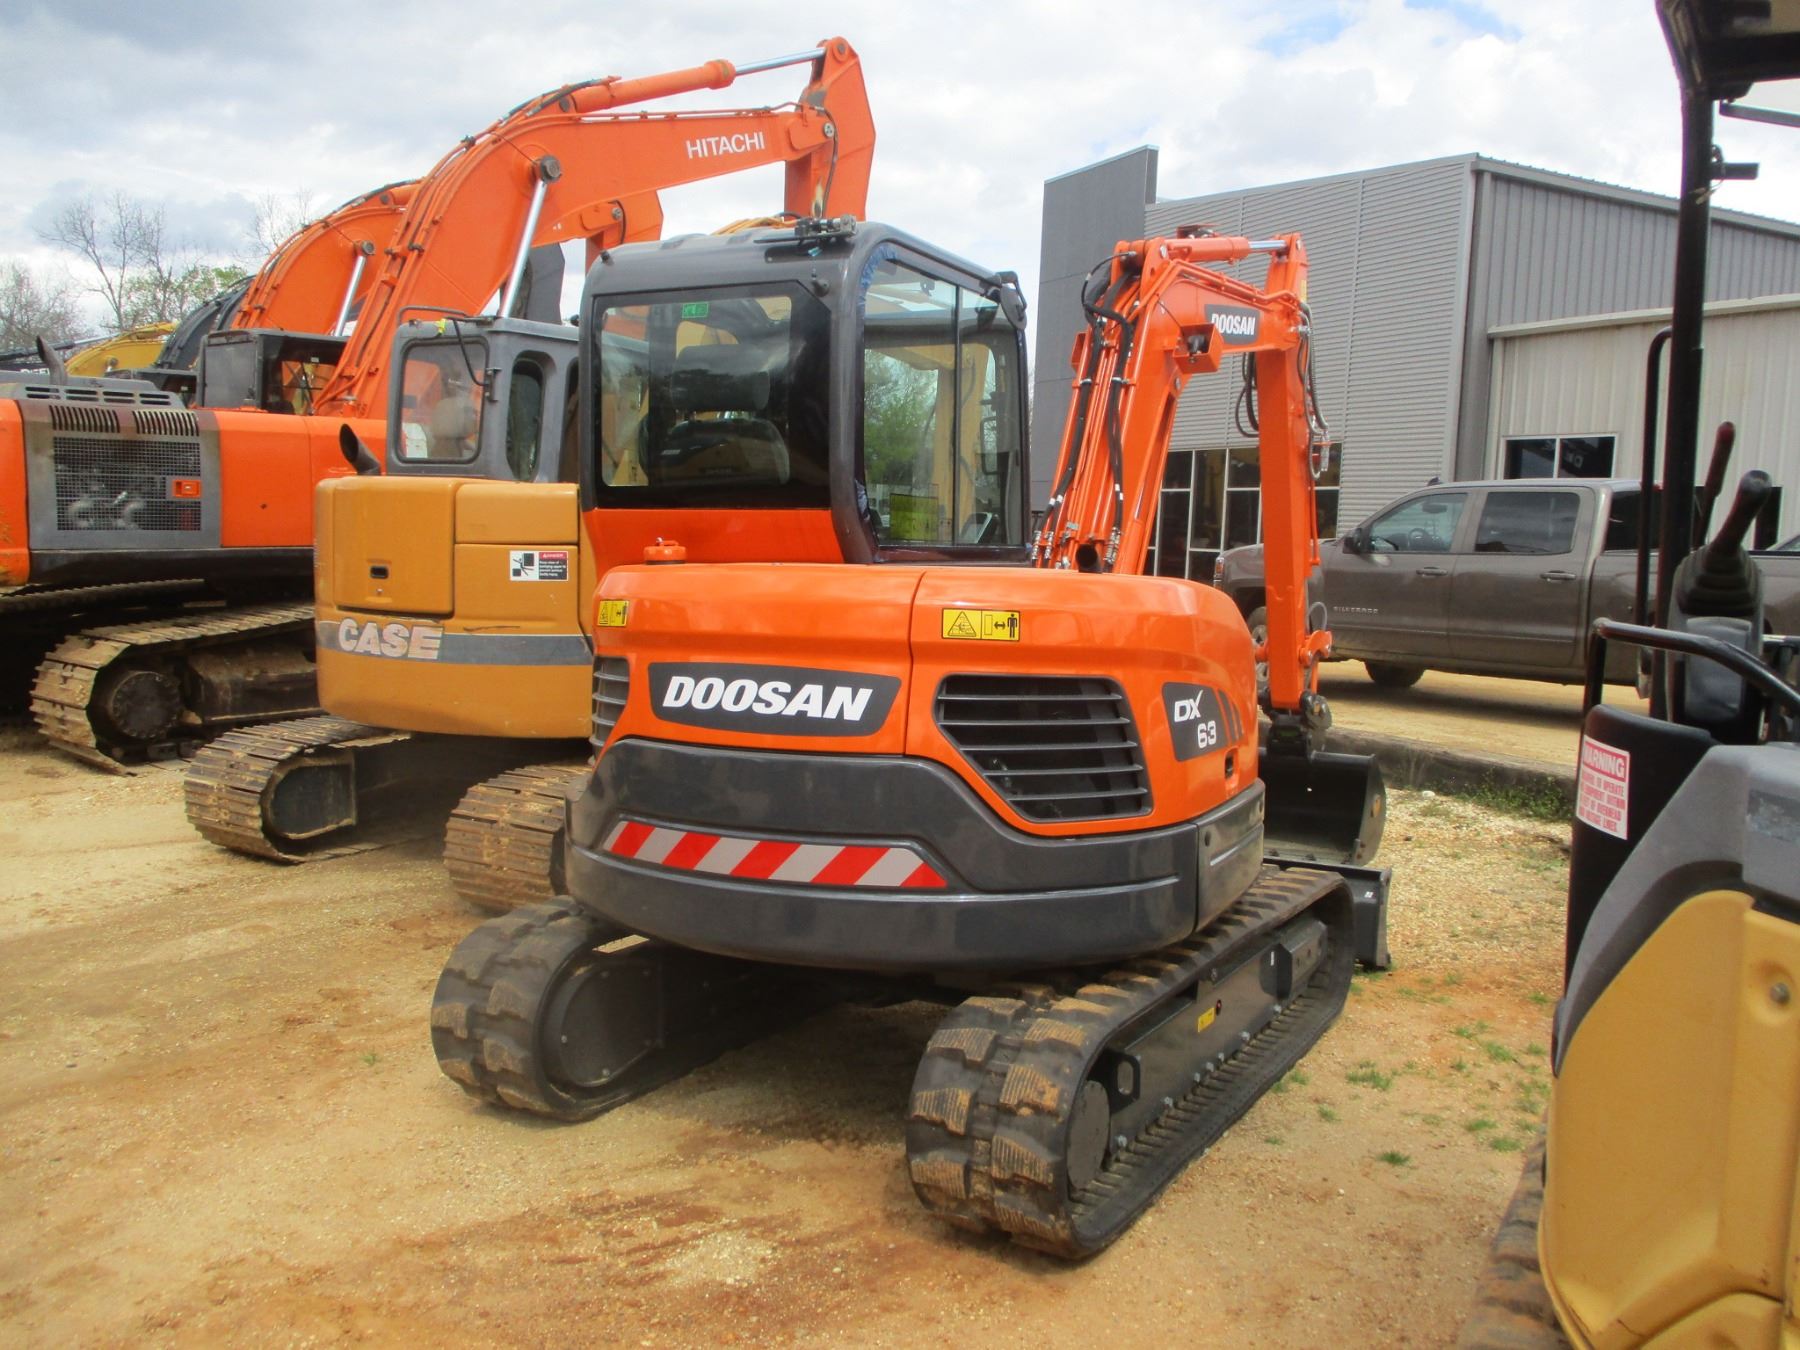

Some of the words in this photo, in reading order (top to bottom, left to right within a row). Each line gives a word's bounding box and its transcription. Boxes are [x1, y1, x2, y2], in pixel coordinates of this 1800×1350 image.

[686, 131, 765, 159] HITACHI
[1211, 313, 1256, 336] DOOSAN
[338, 618, 444, 660] CASE
[662, 675, 873, 721] DOOSAN
[1174, 689, 1204, 723] DX
[1197, 720, 1217, 749] 63
